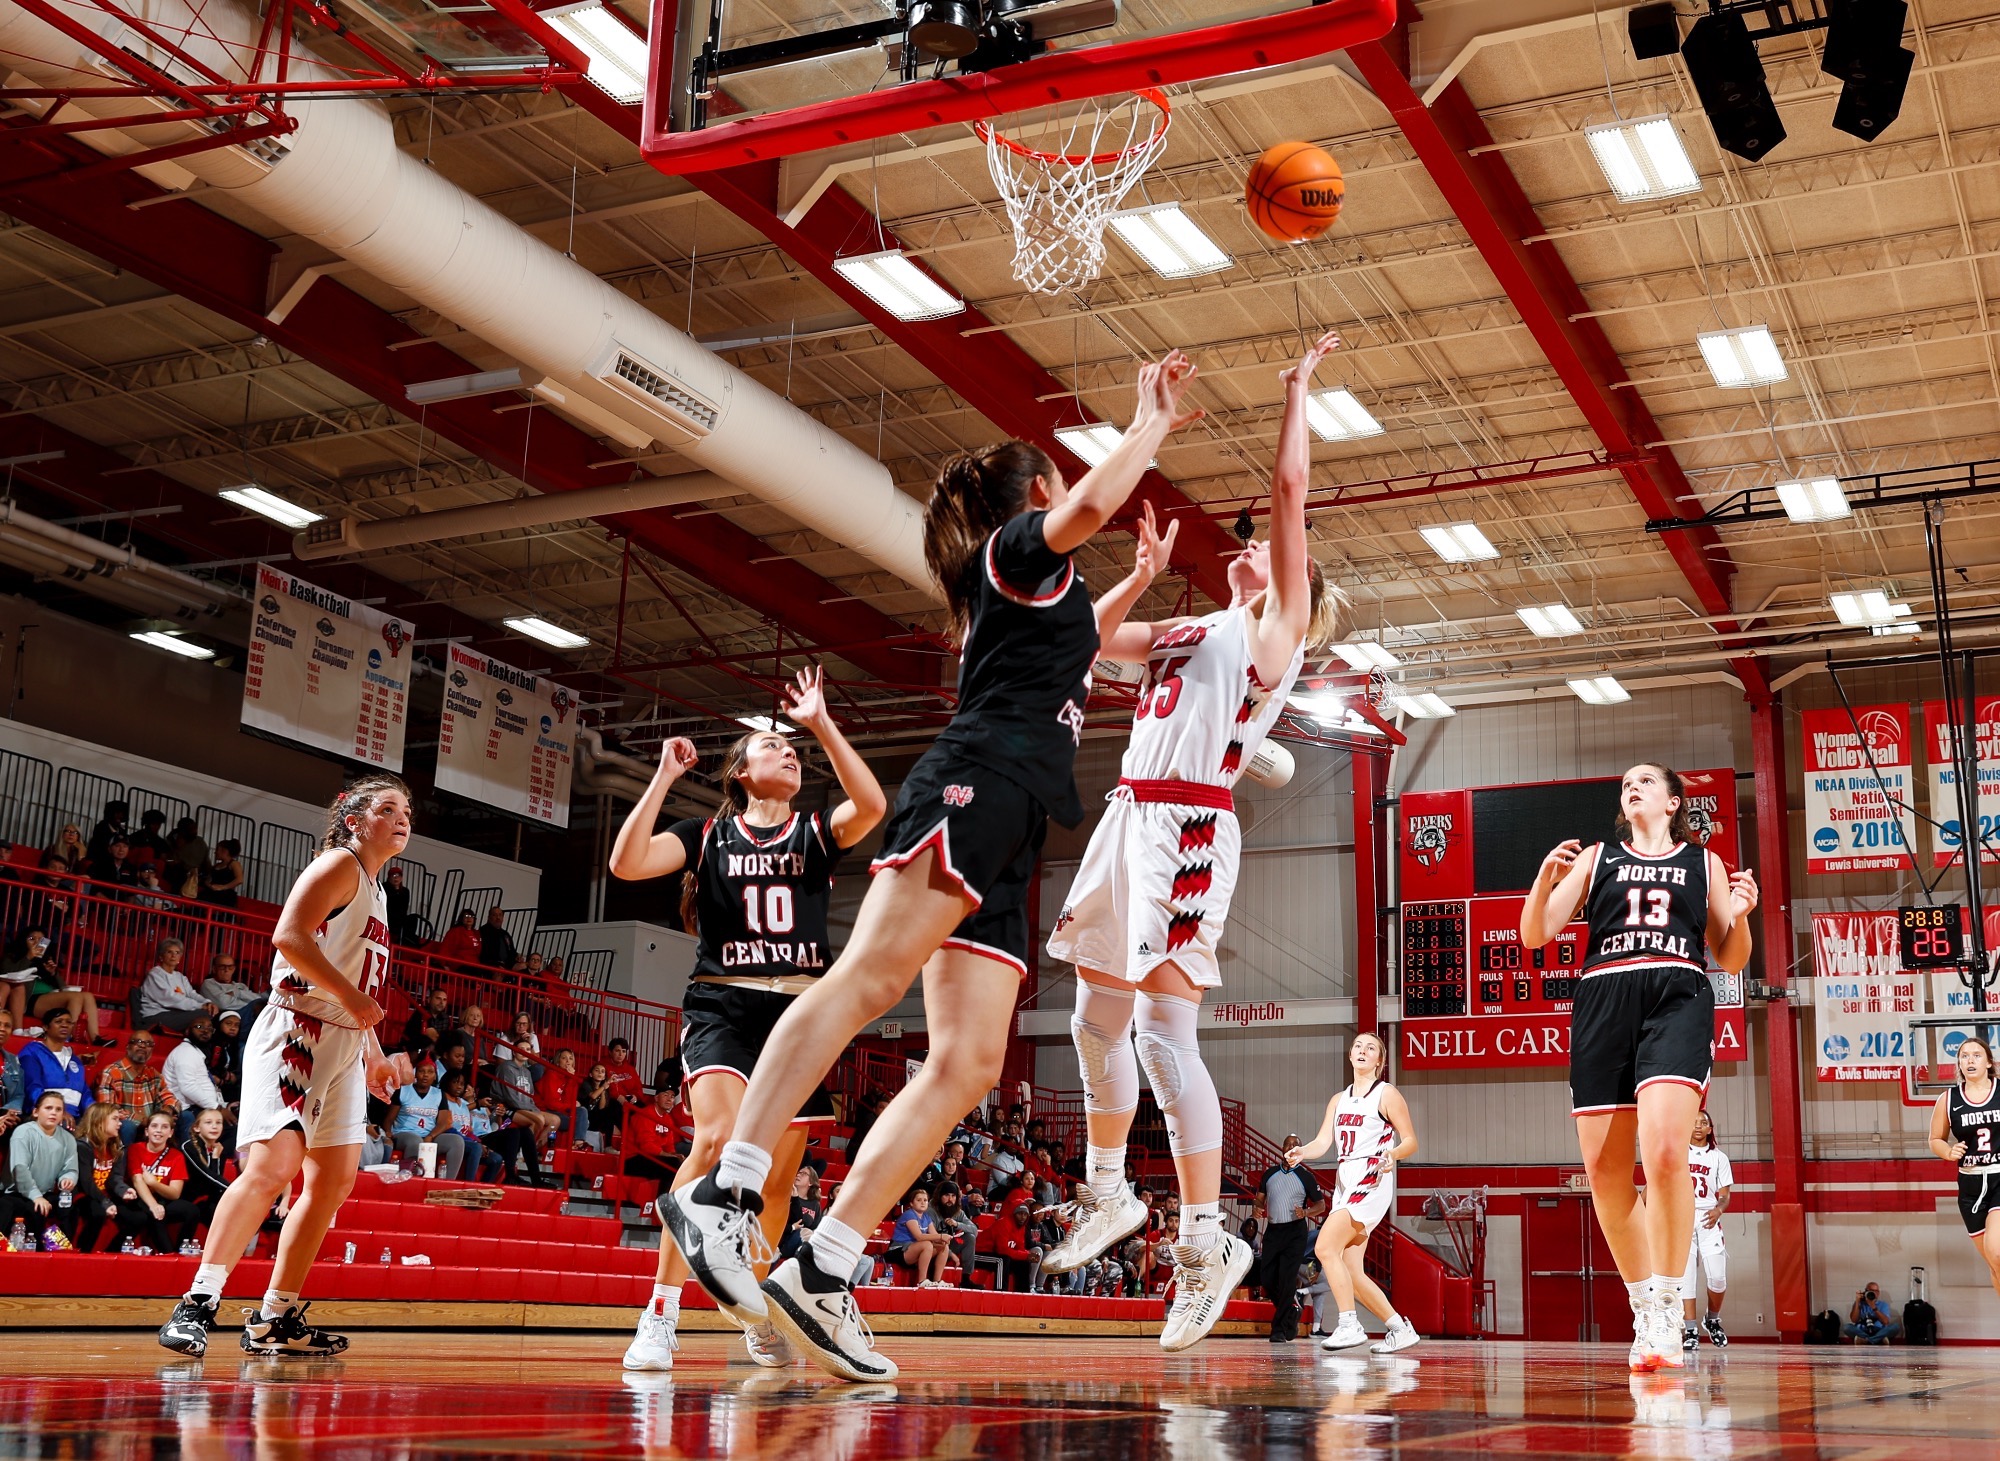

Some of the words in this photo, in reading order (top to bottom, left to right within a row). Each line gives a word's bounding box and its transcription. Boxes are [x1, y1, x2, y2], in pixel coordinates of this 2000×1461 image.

[260, 568, 288, 593] Men's
[290, 579, 350, 619] Basketball
[257, 614, 297, 639] Conference
[255, 627, 293, 649] Champions
[315, 636, 355, 660] Tournament
[312, 648, 349, 670] Champions
[451, 646, 486, 673] Women's
[486, 658, 537, 694] Basketball
[1137, 656, 1192, 720] 35
[446, 699, 478, 719] Champions
[1813, 730, 1877, 749] Women's
[1815, 743, 1899, 769] Volleyball
[1815, 778, 1846, 792] NCAA
[1895, 774, 1903, 787] II
[1686, 795, 1718, 813] YERS
[1409, 814, 1453, 833] FLYERS
[1816, 838, 1840, 847] NCAA
[1851, 821, 1904, 848] 2018
[727, 853, 804, 877] NORTH
[1825, 858, 1851, 871] Lewis
[1853, 857, 1899, 870] University
[1616, 865, 1687, 886] NORTH
[742, 884, 795, 935] 10
[1405, 905, 1423, 917] PLY
[1428, 904, 1441, 916] FL
[1444, 903, 1464, 915] PTS
[1625, 887, 1672, 928] 13
[1904, 910, 1944, 927] 28.8
[1407, 936, 1424, 950] 21
[1430, 935, 1439, 949] 0
[1483, 929, 1517, 942] LEWIS
[1555, 933, 1577, 942] GAME
[1825, 935, 1867, 954] Men's
[1914, 928, 1950, 957] 26
[722, 939, 824, 968] CENTRAL
[1600, 931, 1690, 960] CENTRAL
[1407, 953, 1424, 967] 23
[1431, 952, 1439, 966] 0
[1455, 951, 1463, 965] 6
[1490, 945, 1519, 969] 60
[1561, 945, 1572, 964] 3
[358, 948, 387, 997] 13
[1407, 969, 1425, 983] 35
[1445, 967, 1463, 981] 22
[1479, 972, 1504, 982] FOULS
[1512, 971, 1533, 980] T.O.L.
[1540, 970, 1570, 979] PLAYER
[1407, 986, 1425, 999] 42
[1431, 985, 1439, 999] 0
[1455, 984, 1463, 998] 2
[1489, 983, 1500, 1000] 4
[1518, 981, 1528, 1000] 3
[1826, 984, 1859, 999] NCAA
[1861, 983, 1914, 998] National
[1947, 991, 1974, 1006] NCA
[1213, 1002, 1284, 1026] #FlightOn
[1484, 1005, 1502, 1014] WON
[1843, 998, 1914, 1013] Semifinalist
[885, 1023, 898, 1034] EXIT
[1406, 1030, 1486, 1058] NEIL
[1495, 1027, 1571, 1055] CAR
[1860, 1031, 1915, 1058] 2021
[1835, 1066, 1862, 1080] Lewis
[1863, 1065, 1901, 1080] Universi
[418, 1118, 425, 1129] 4
[1961, 1109, 2000, 1127] NORTH
[1340, 1130, 1356, 1157] 21
[1977, 1127, 1992, 1152] 2
